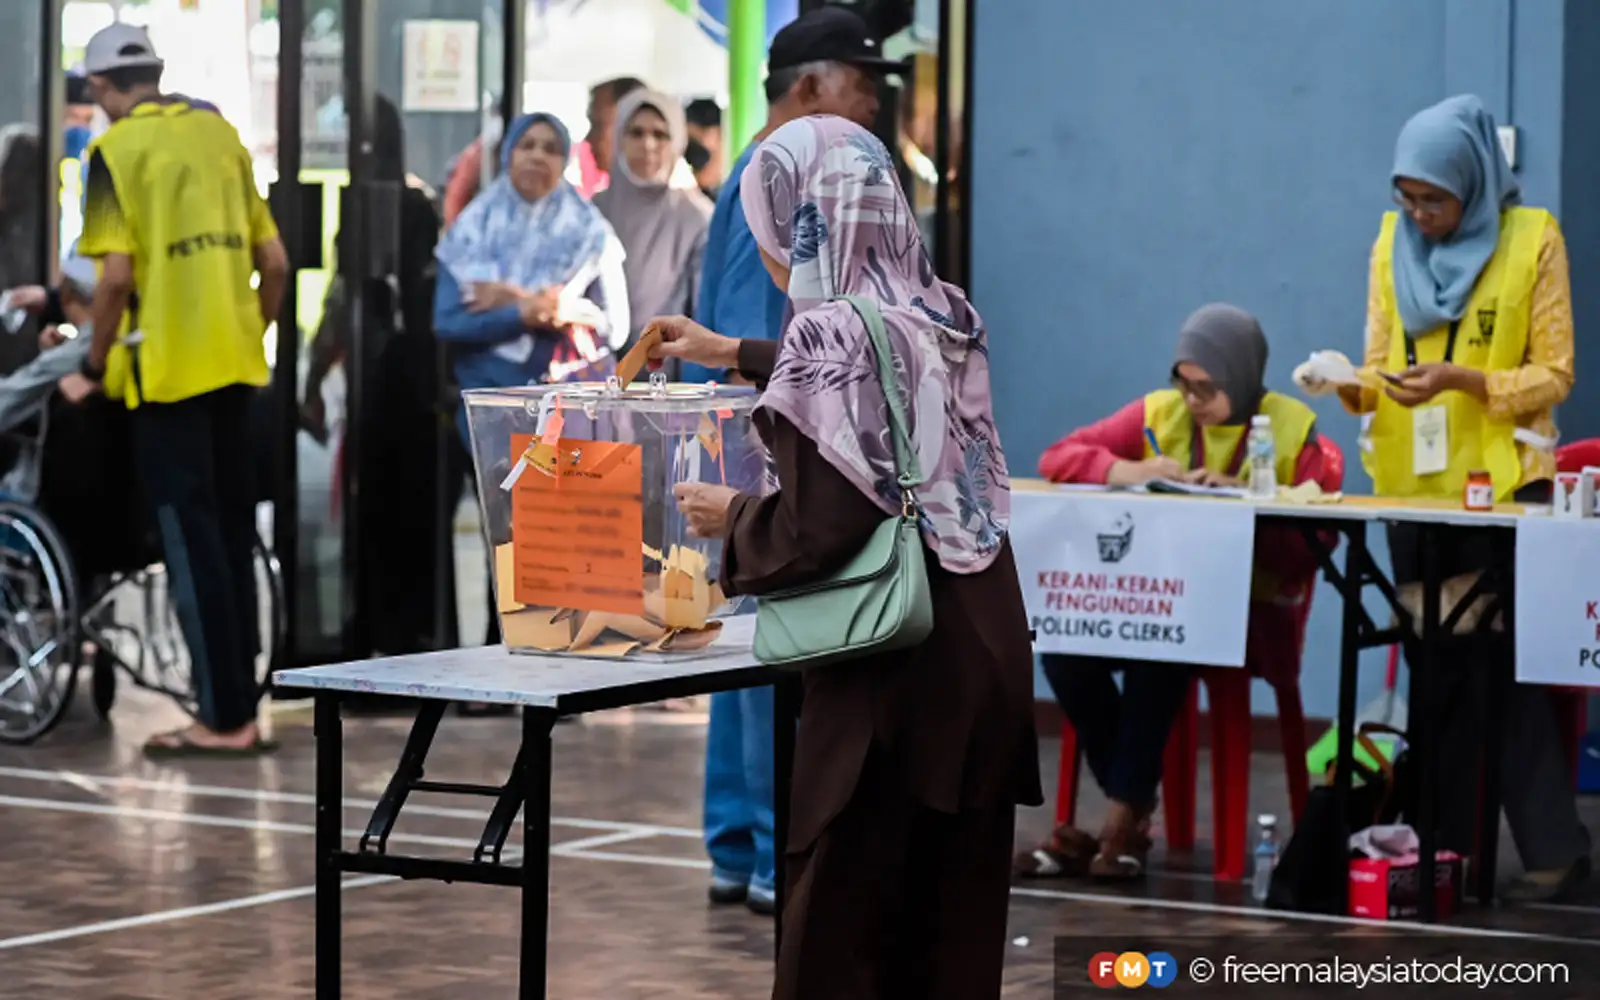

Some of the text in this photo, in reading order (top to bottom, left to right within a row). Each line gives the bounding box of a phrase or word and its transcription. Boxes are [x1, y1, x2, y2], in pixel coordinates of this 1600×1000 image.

[166, 231, 243, 261] PETU
[1037, 571, 1185, 597] KERANI-KERANI
[1045, 591, 1173, 618] PENGUNDIAN
[1031, 615, 1186, 645] POLLING CLERKS
